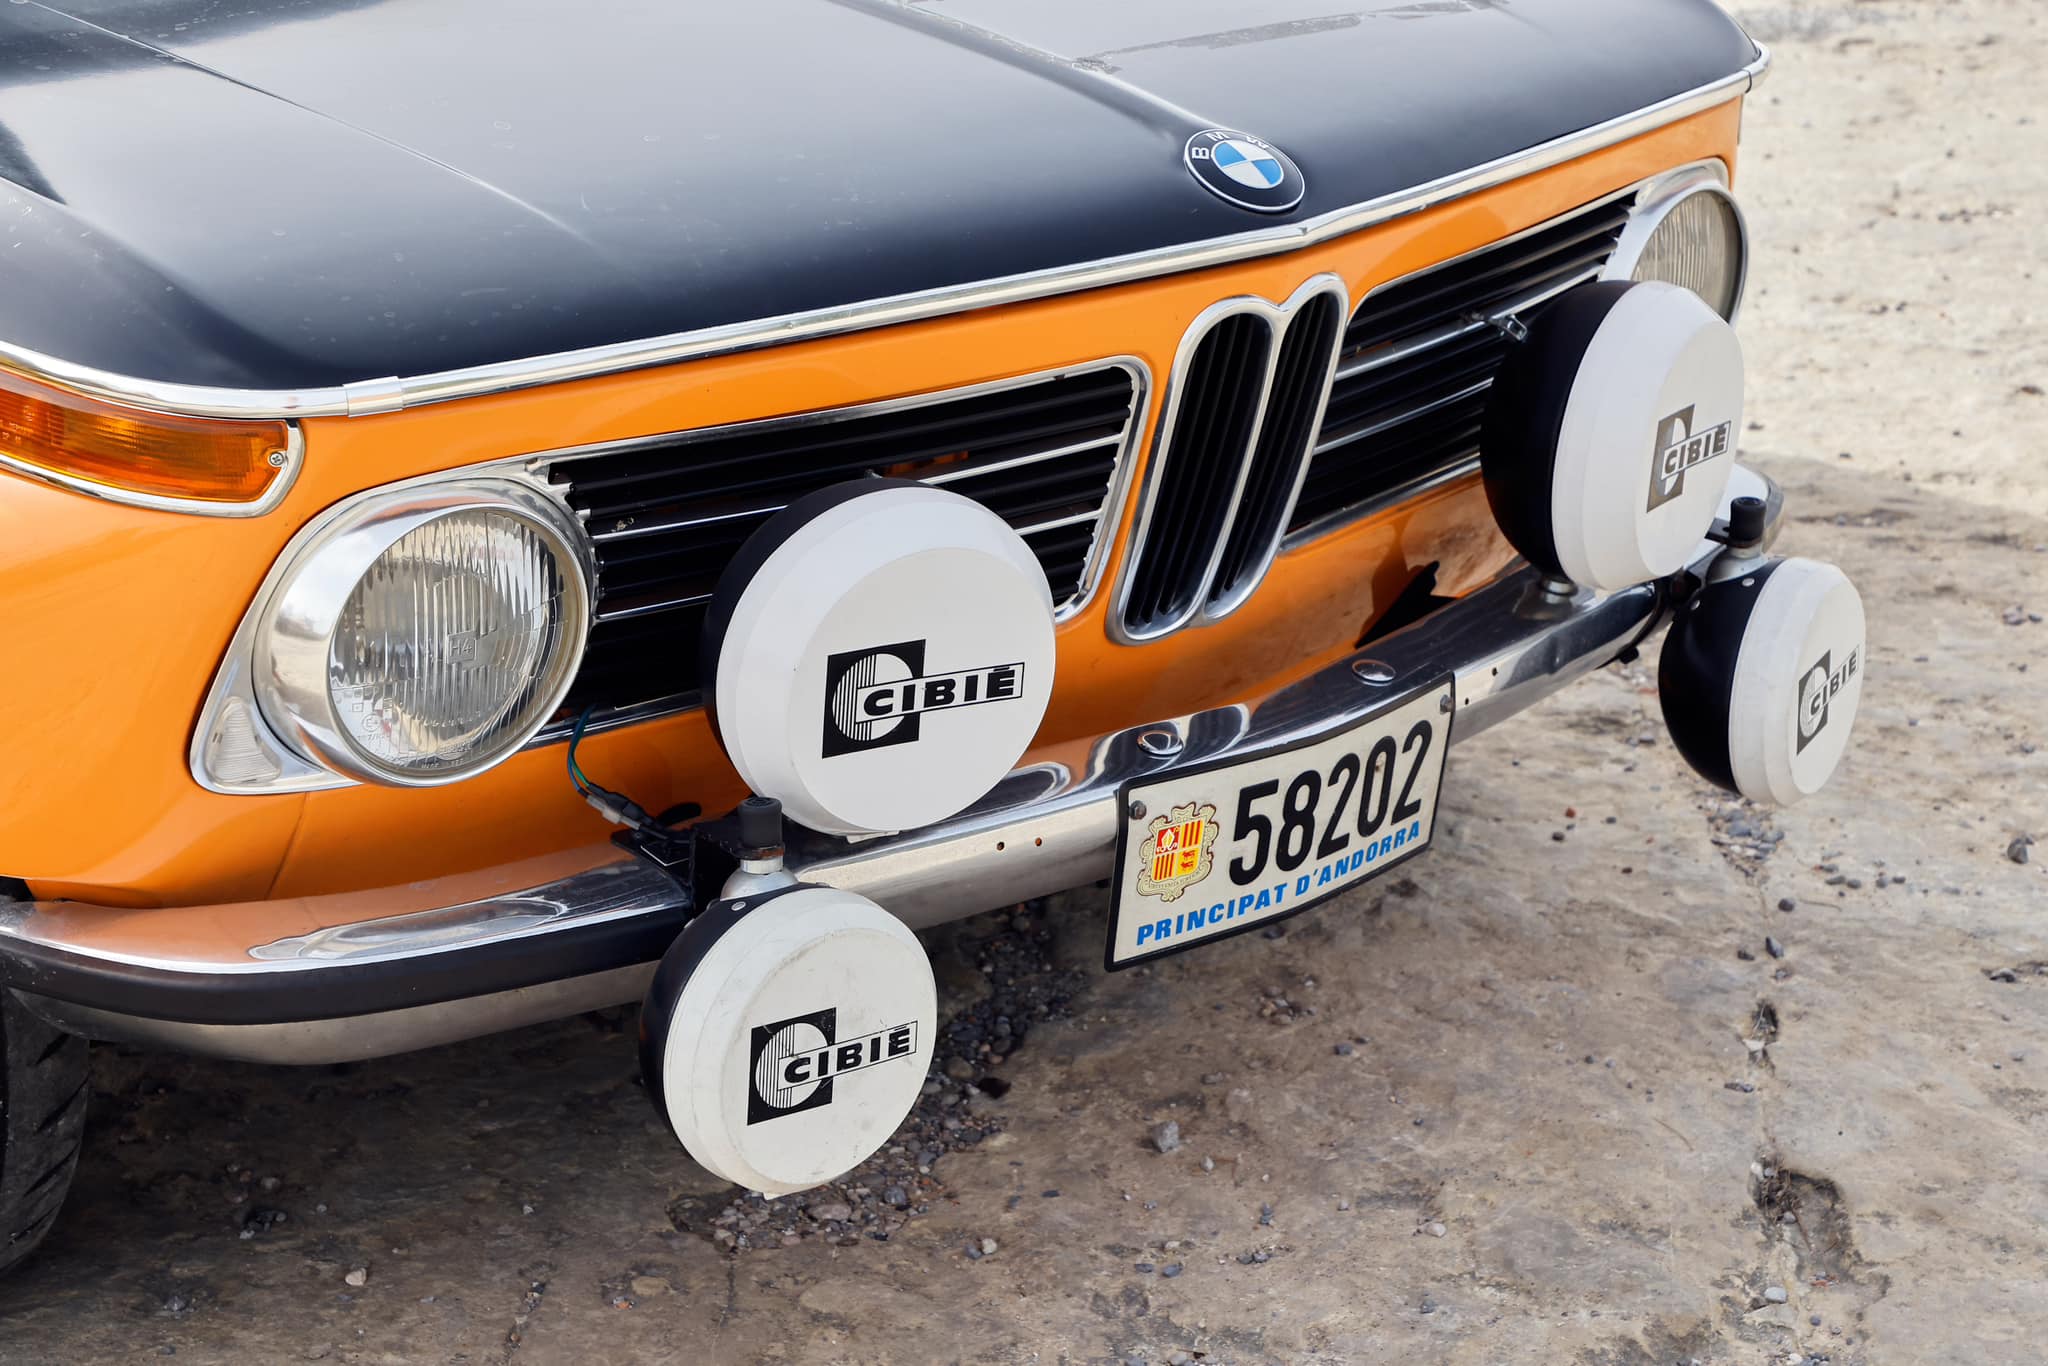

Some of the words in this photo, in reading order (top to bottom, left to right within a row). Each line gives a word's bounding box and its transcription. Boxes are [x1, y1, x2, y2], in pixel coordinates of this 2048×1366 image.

[1191, 131, 1269, 160] BMW
[1229, 719, 1433, 886] 58202
[1136, 881, 1288, 946] PRINCIPAT
[1295, 820, 1421, 897] D'ANDORRA
